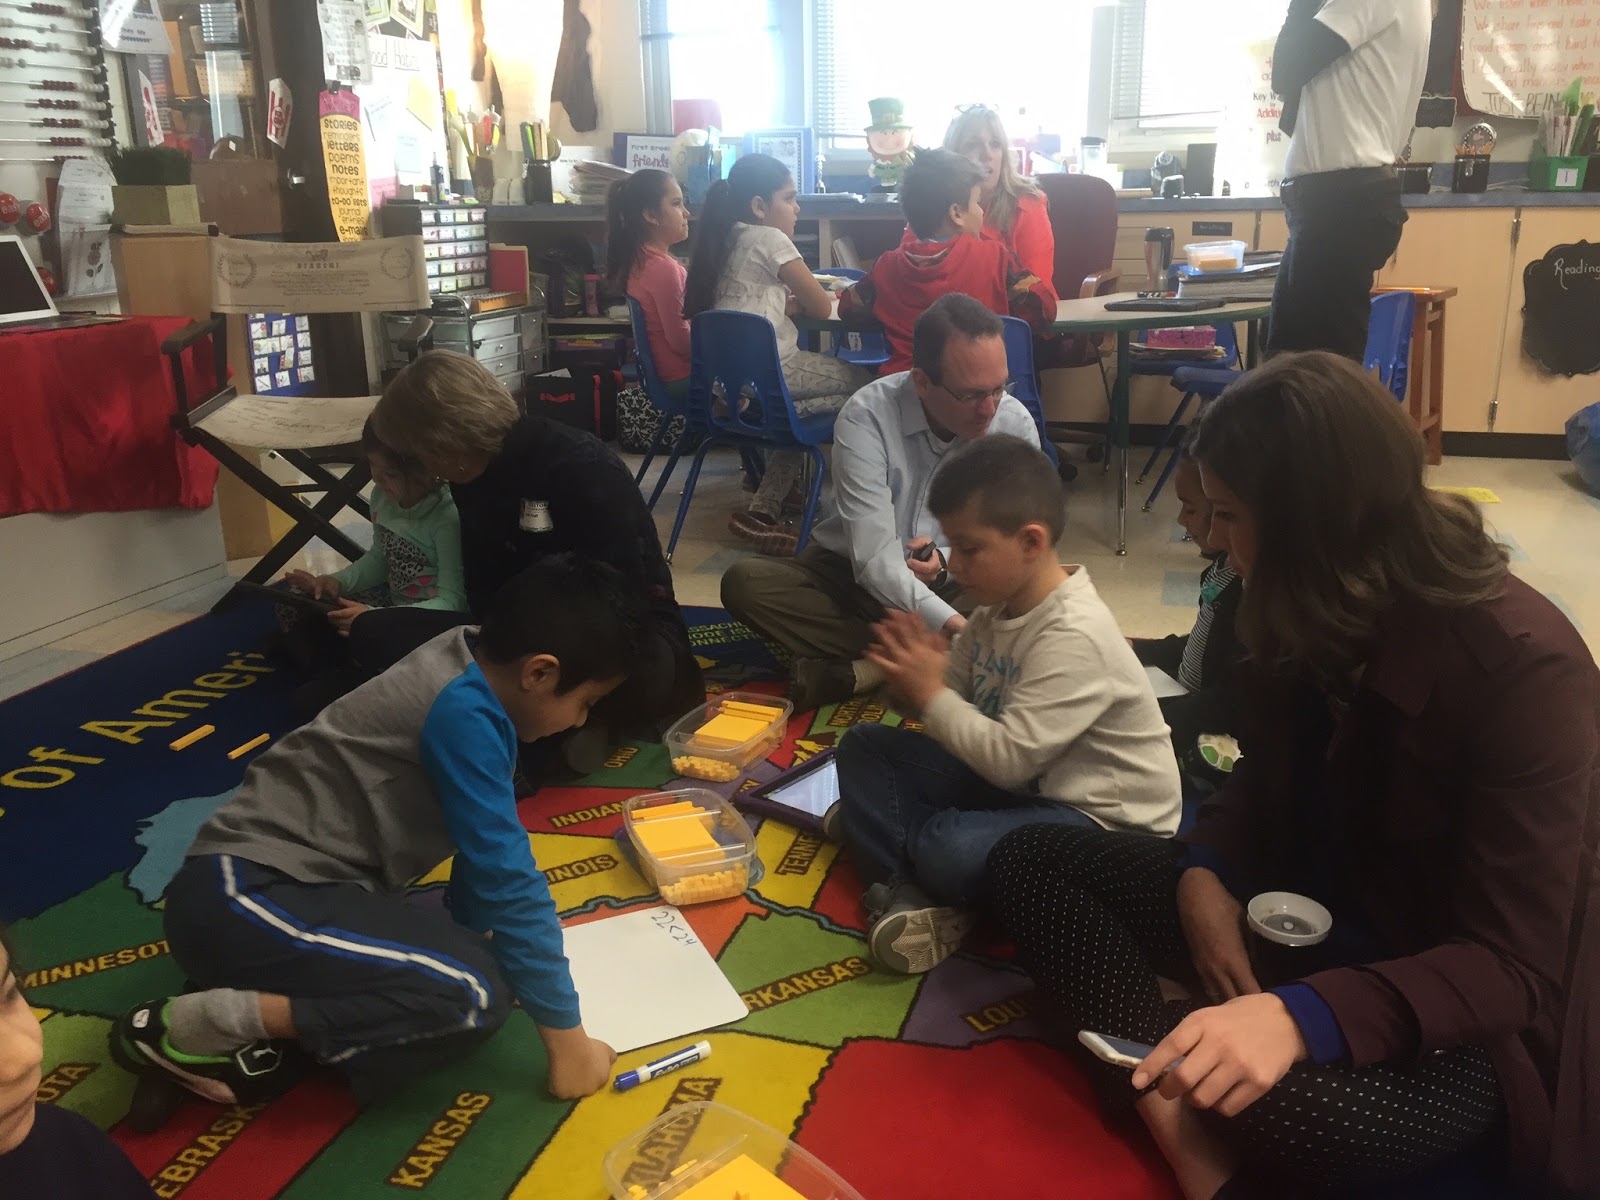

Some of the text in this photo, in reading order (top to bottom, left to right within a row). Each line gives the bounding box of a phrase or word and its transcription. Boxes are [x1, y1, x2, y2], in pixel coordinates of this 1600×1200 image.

[1257, 108, 1282, 119] Additi
[331, 163, 360, 176] notes
[632, 153, 669, 169] friends
[0, 746, 106, 789] of
[546, 856, 615, 883] INOIS
[22, 938, 171, 989] MINNESOT
[740, 957, 870, 1011] RKANSAS
[390, 1092, 491, 1188] KANSAS
